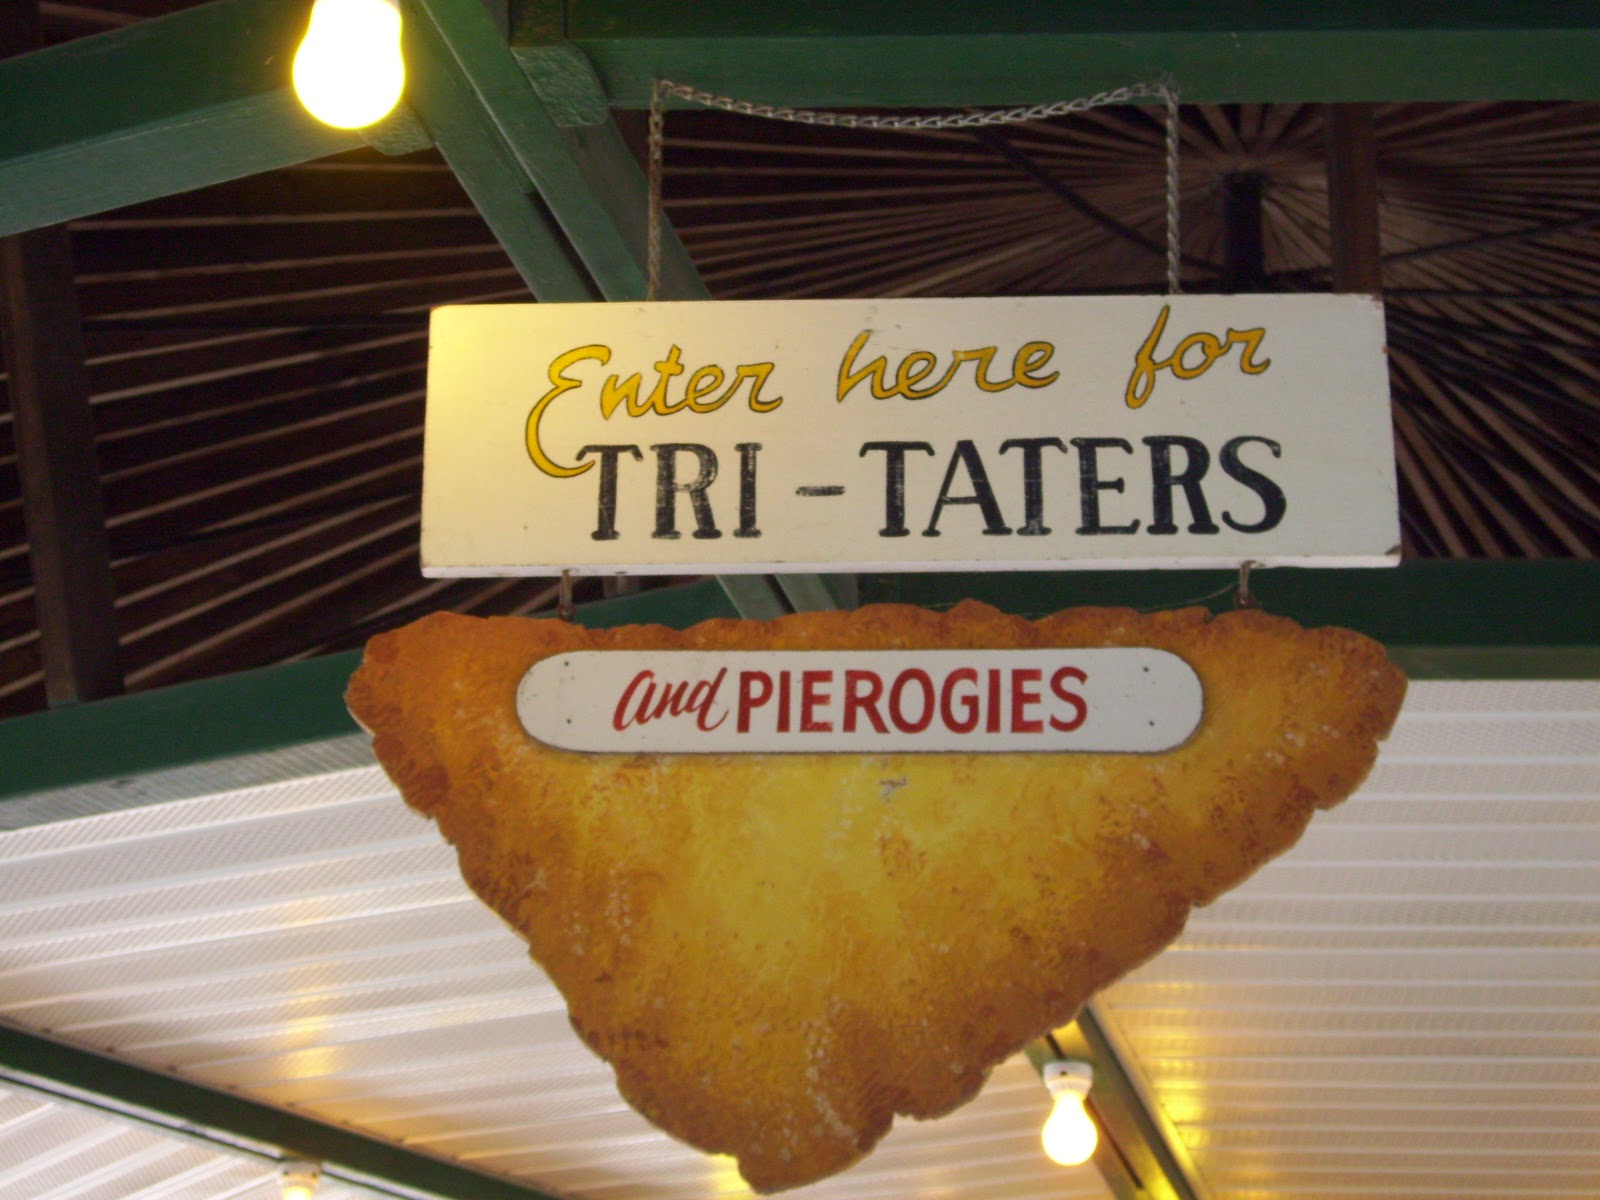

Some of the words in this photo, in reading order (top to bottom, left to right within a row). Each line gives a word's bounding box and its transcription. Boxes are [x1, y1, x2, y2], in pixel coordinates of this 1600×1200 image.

[525, 344, 783, 478] Enter
[837, 329, 1060, 403] here
[1125, 304, 1271, 409] for
[612, 666, 729, 732] and
[736, 667, 1088, 734] PIEROGIES
